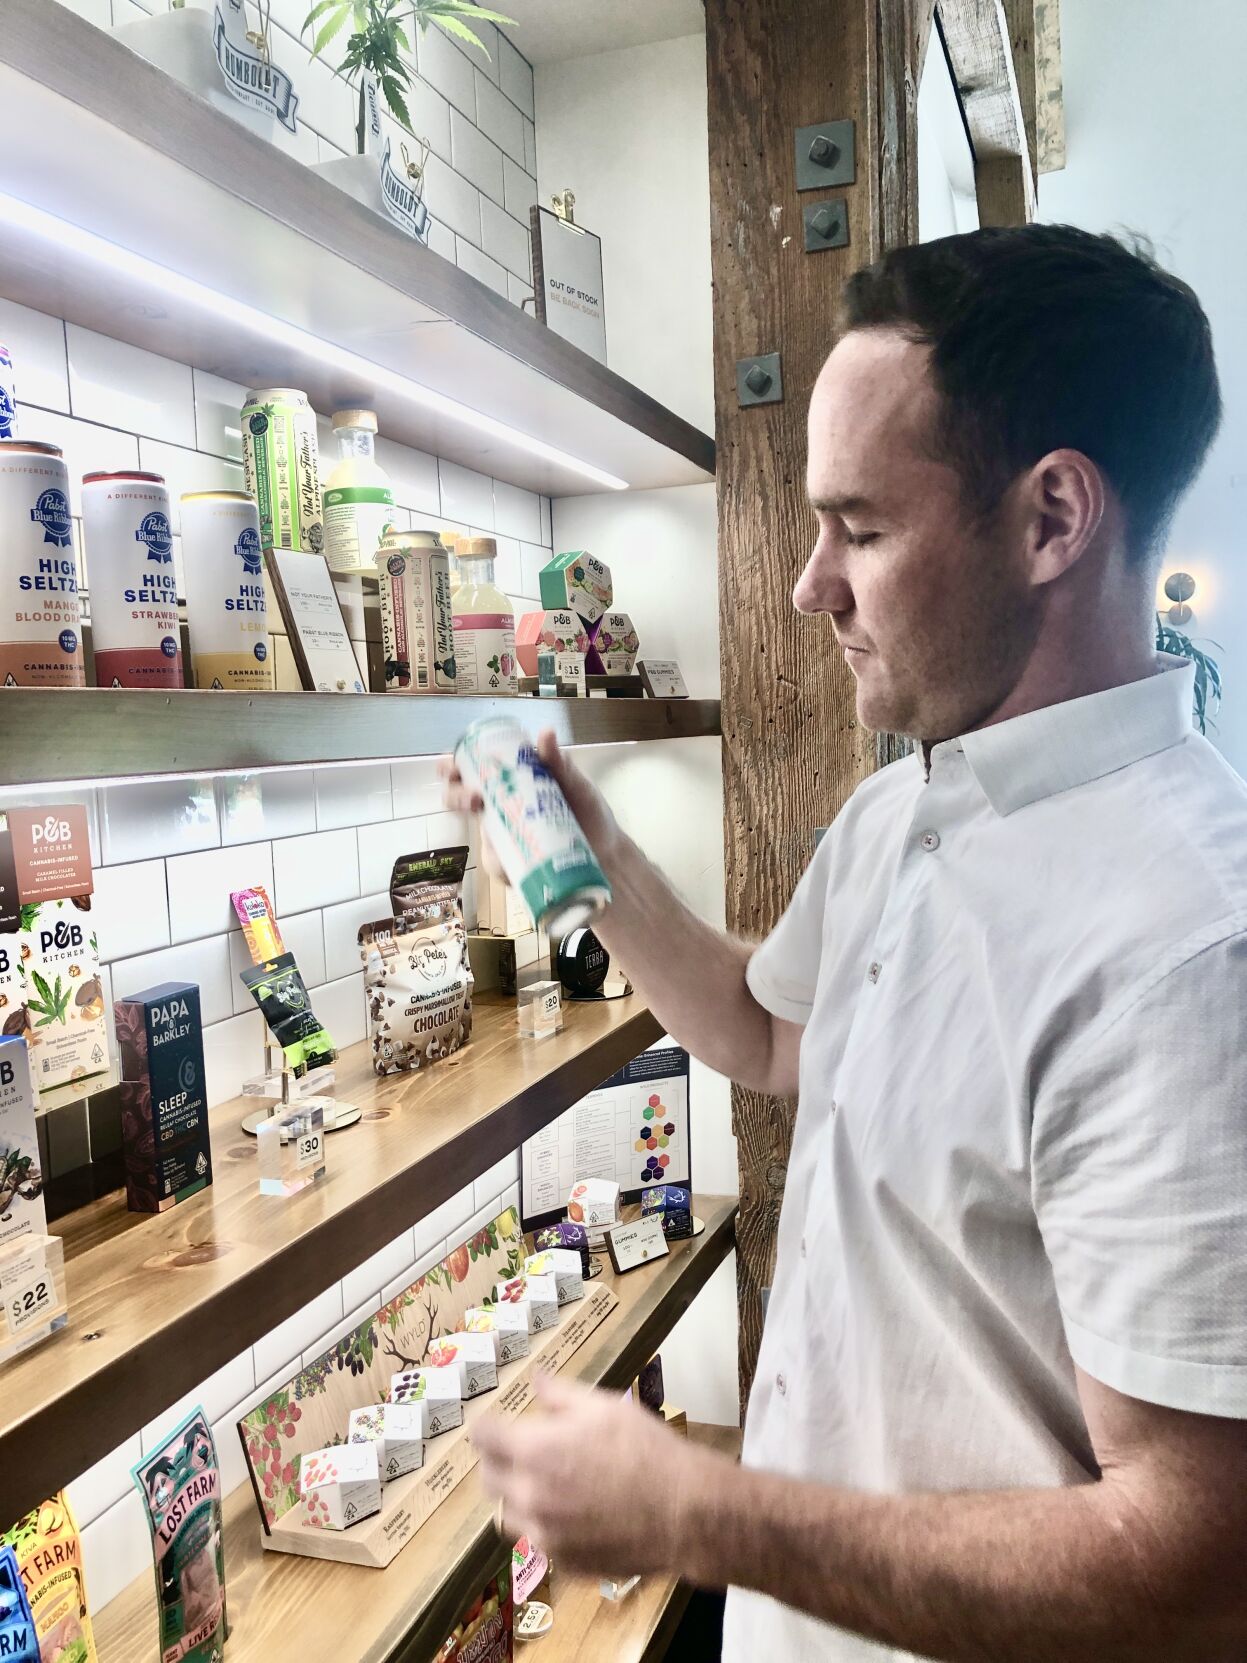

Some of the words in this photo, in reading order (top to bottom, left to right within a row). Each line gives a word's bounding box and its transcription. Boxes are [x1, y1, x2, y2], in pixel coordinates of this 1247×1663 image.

[225, 46, 280, 99] HUMBOLDT
[384, 169, 419, 218] HUMBOLDT
[549, 279, 565, 291] OUT
[577, 291, 599, 306] STOCK
[550, 292, 561, 300] BE
[299, 432, 312, 470] Father's
[9, 467, 54, 476] DIFFERENT
[301, 469, 314, 496] Your
[44, 494, 67, 513] Pabst
[303, 496, 314, 517] Not
[33, 510, 53, 522] Blue
[145, 517, 167, 532] Pabst
[138, 531, 156, 541] Blue
[236, 545, 249, 555] Blue
[39, 559, 77, 575] HIGH
[588, 558, 603, 575] P&B
[143, 574, 176, 588] HIGH
[435, 571, 446, 608] Father's
[16, 612, 61, 622] BLOOD
[157, 621, 176, 629] KIWI
[436, 608, 447, 633] Your
[554, 613, 571, 625] P&B
[610, 616, 625, 627] P&B
[383, 617, 391, 653] ROOT
[437, 634, 447, 653] Not
[565, 665, 580, 675] $15
[31, 816, 71, 844] P&B
[33, 843, 73, 854] KITCHEN
[29, 855, 79, 866] CANNABIS-INFUSED
[408, 859, 437, 872] EMERALD
[405, 889, 421, 900] MILK
[420, 885, 454, 895] CHOCOLATE
[40, 921, 83, 953] P&B
[375, 930, 391, 943] 100
[43, 948, 85, 963] KITCHEN
[585, 950, 604, 970] TERRA
[404, 1005, 424, 1017] CRISPY
[424, 995, 455, 1011] MARSHMALLOW
[545, 995, 558, 1009] $20
[151, 998, 189, 1028] PAPA
[414, 1005, 460, 1034] CHOCOLATE
[153, 1022, 191, 1047] BARKLEY
[159, 1091, 188, 1114] SLEEP
[160, 1099, 202, 1123] CANNABIS-INFUSED
[175, 1109, 197, 1124] CHOCOLATE
[161, 1130, 174, 1141] CBD
[186, 1117, 199, 1129] CBN
[300, 1137, 319, 1154] $30
[615, 1232, 638, 1245] GUMMIES
[12, 1282, 48, 1317] $22
[15, 1299, 50, 1326] PROVISIONS
[400, 1320, 425, 1348] WYLD
[425, 1460, 450, 1487] HUCKLEBERRY
[159, 1495, 187, 1544] LOST
[383, 1510, 405, 1533] RASPBERRY
[21, 1542, 37, 1558] KIVA
[33, 1540, 76, 1576] FARM
[30, 1570, 72, 1607] NABIS-INFUSED
[523, 1609, 539, 1628] 2.50
[0, 1628, 27, 1656] RM
[188, 1626, 209, 1648] LIVE
